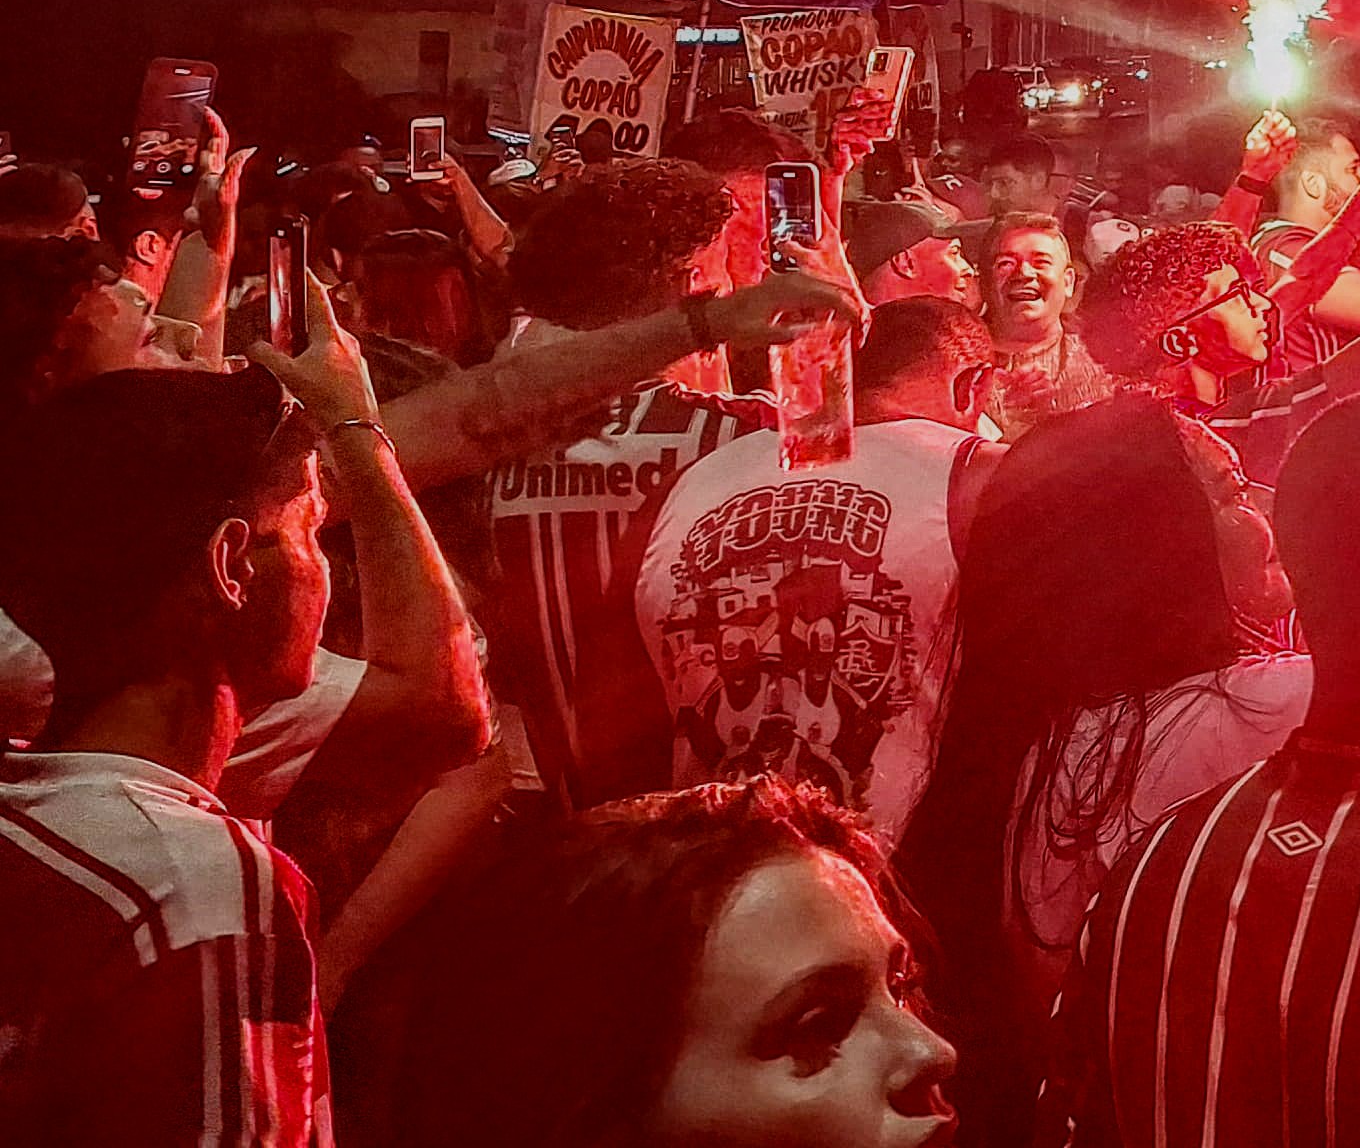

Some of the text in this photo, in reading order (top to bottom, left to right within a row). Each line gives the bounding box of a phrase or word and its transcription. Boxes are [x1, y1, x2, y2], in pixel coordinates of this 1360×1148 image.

[547, 17, 665, 87] CAIPIRINHA
[500, 447, 678, 501] Unimed
[687, 480, 892, 573] YOUNG
